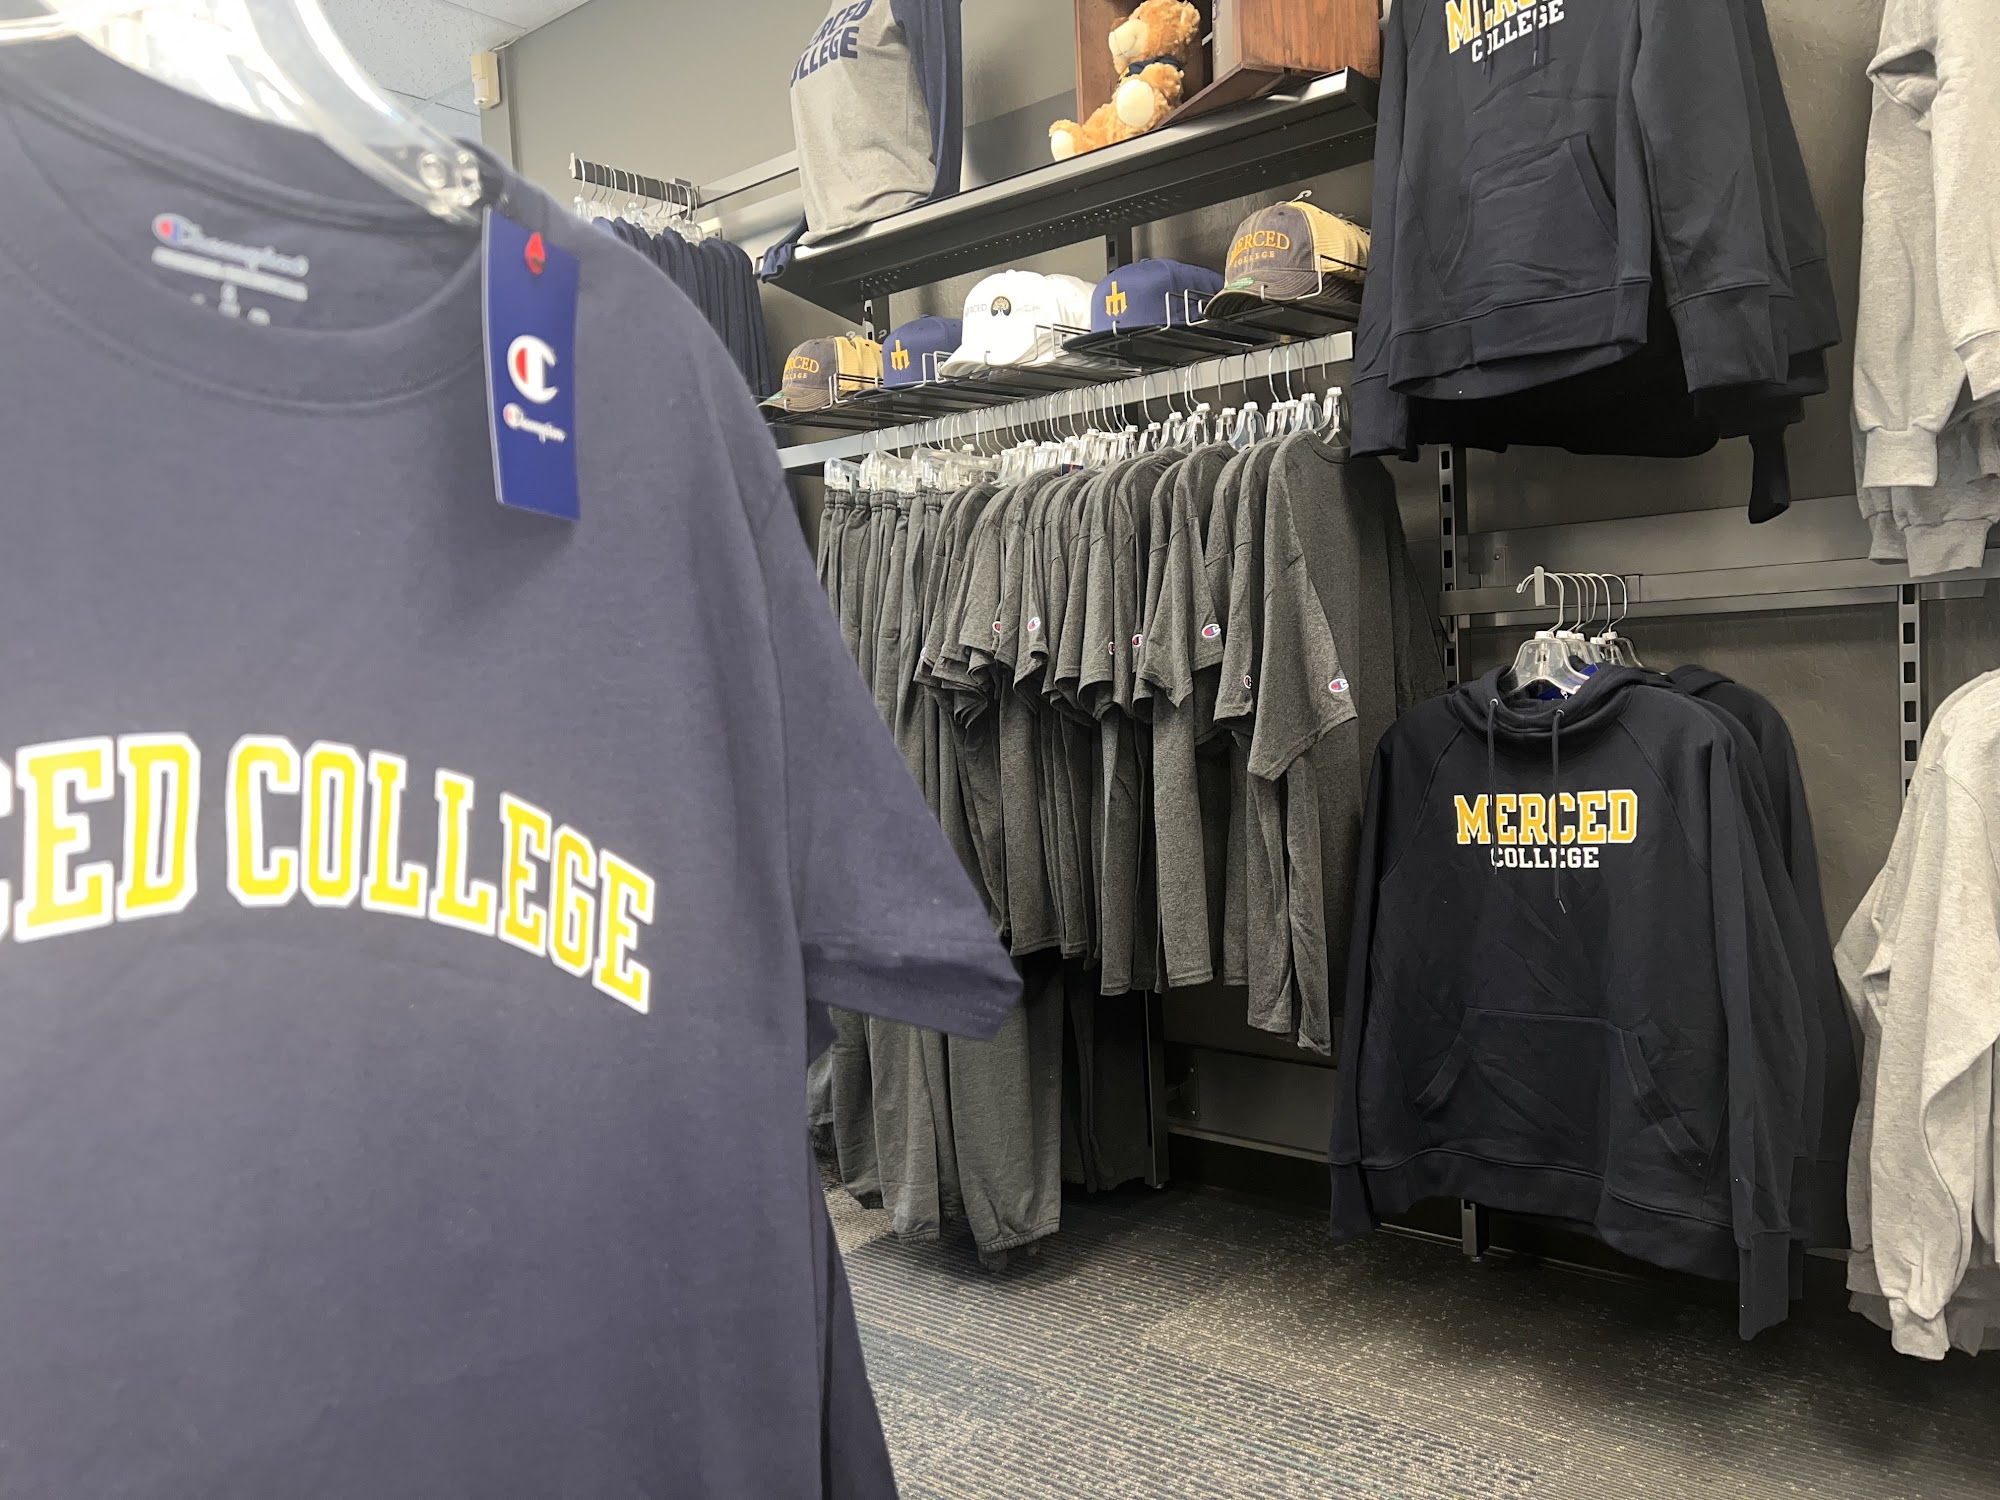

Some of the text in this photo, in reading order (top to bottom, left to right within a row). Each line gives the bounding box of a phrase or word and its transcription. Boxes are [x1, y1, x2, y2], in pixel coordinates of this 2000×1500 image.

[1453, 789, 1638, 845] MERCED
[226, 733, 655, 1014] COLLEGE
[1491, 847, 1600, 869] COLLEGE
